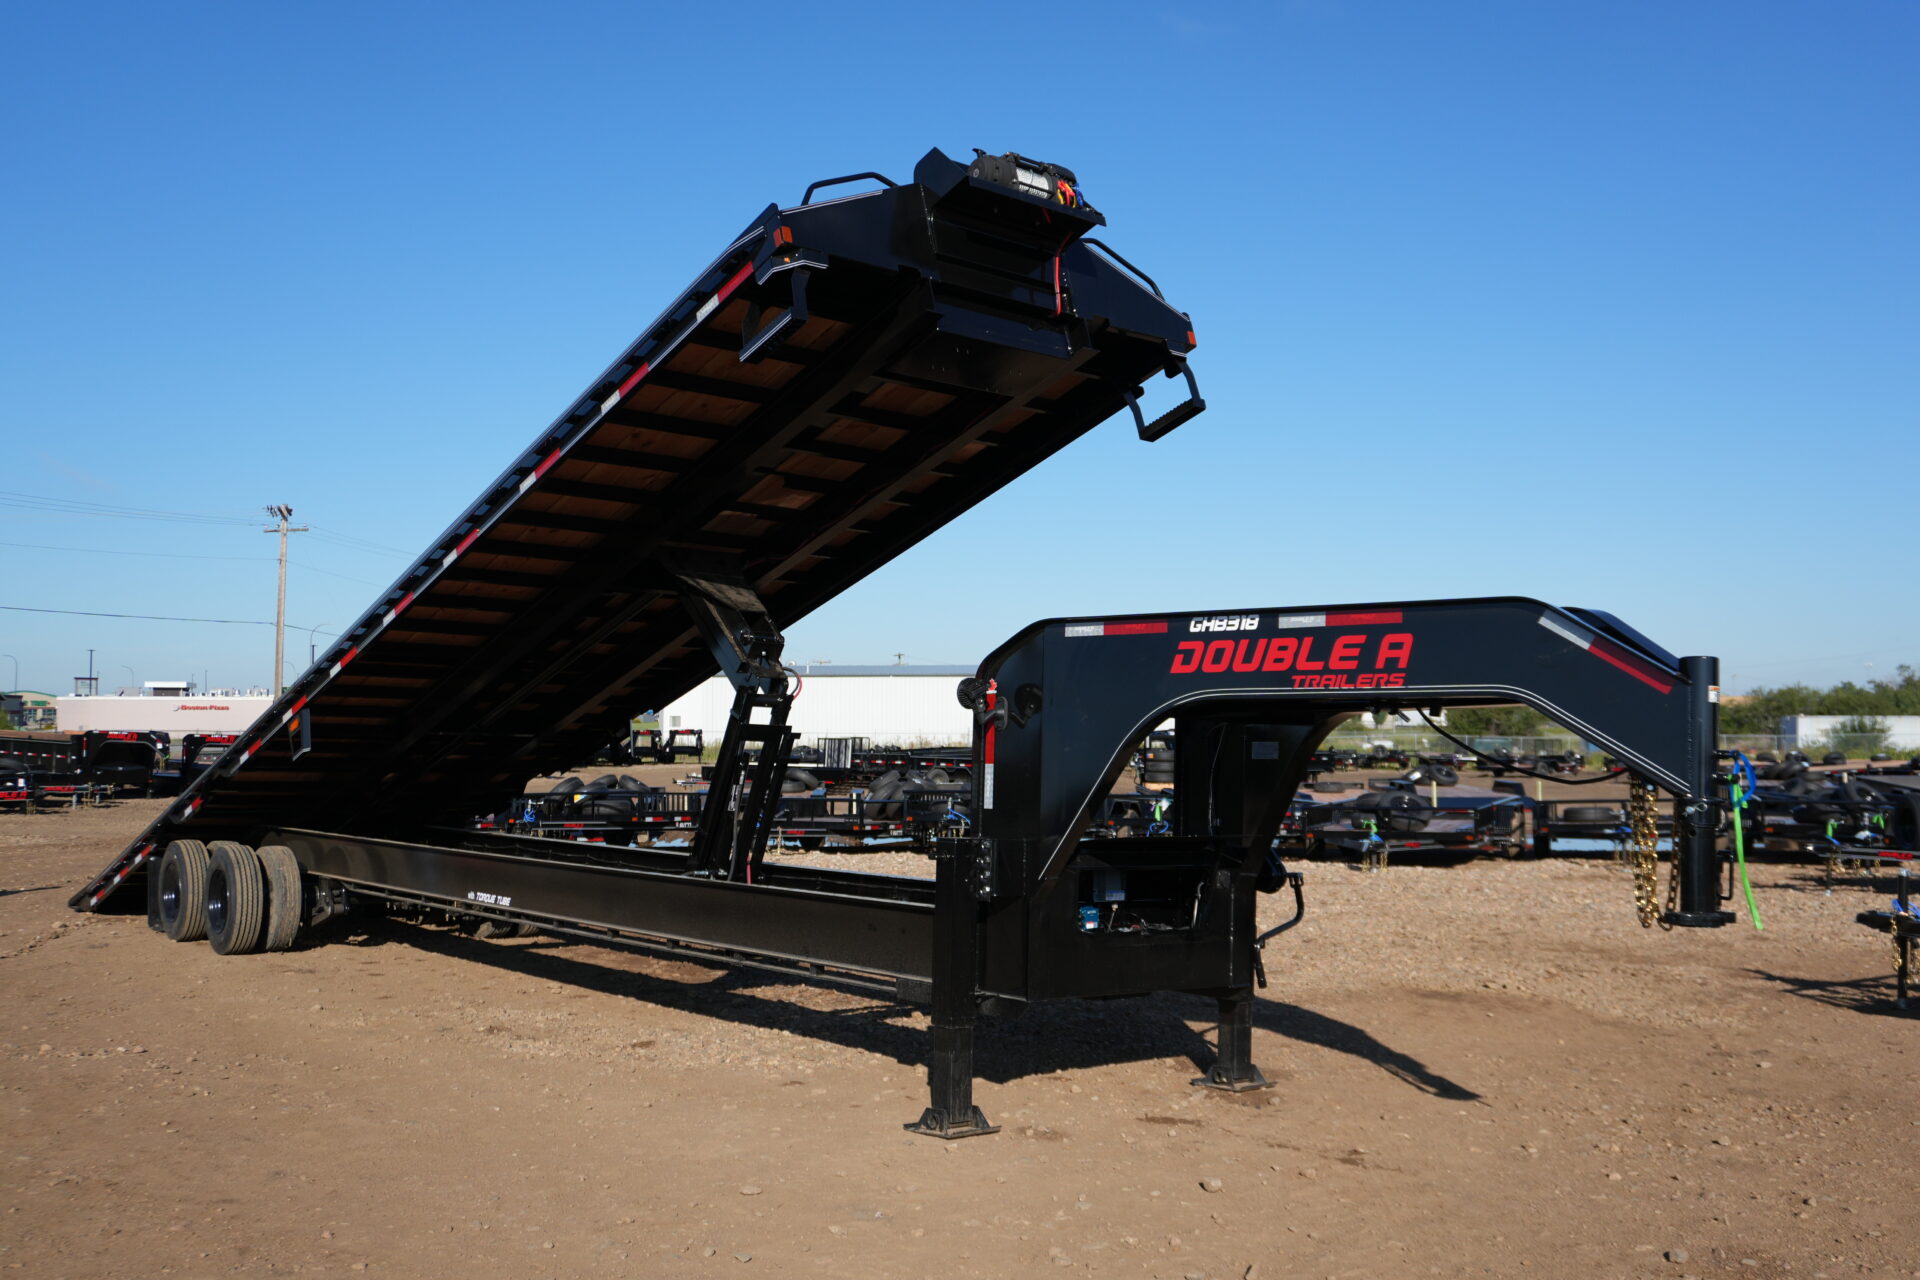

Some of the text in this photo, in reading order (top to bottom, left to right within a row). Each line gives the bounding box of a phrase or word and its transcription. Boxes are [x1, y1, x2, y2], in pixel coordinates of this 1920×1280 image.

[1189, 614, 1260, 633] GHB318
[1170, 633, 1414, 673] DOUBLE A
[1291, 673, 1406, 688] TRAILERS
[476, 892, 497, 904] TORQUE
[497, 895, 512, 907] TUBE
